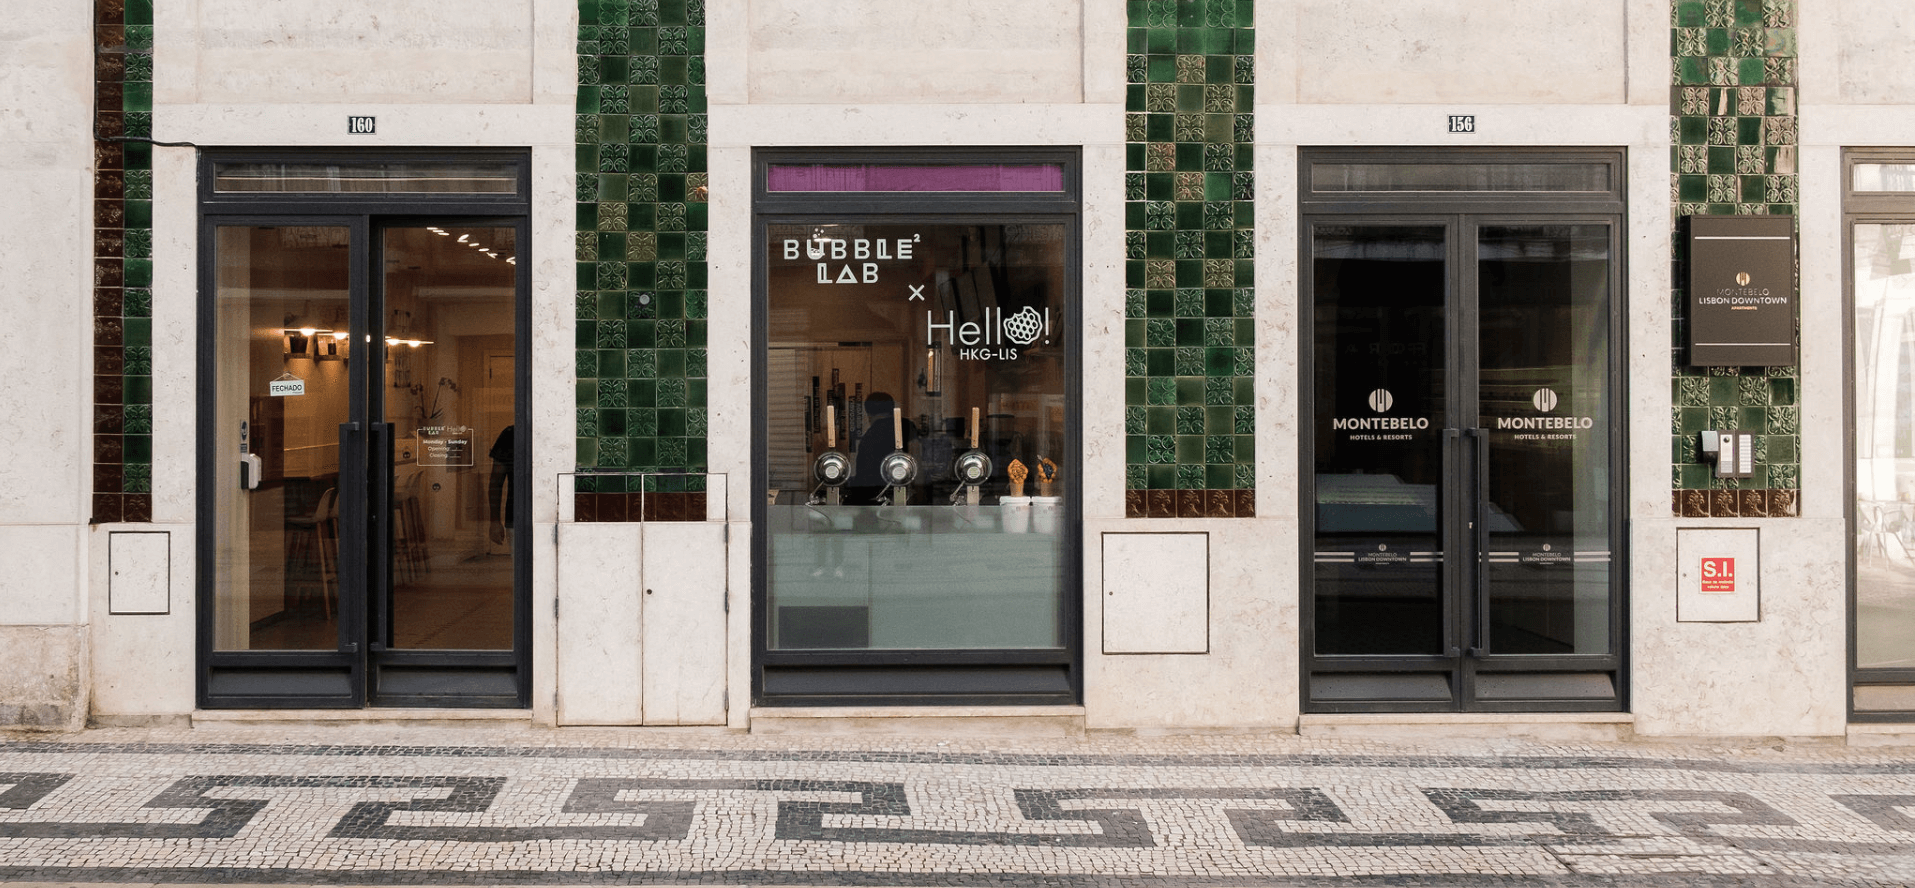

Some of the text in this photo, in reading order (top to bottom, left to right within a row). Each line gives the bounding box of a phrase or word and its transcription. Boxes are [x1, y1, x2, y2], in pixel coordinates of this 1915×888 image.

[351, 117, 373, 133] 160
[1451, 116, 1473, 132] 156
[817, 262, 879, 284] LAB
[1716, 288, 1770, 296] MONTEBELO
[960, 348, 1018, 360] HKG-LIS
[271, 384, 303, 392] FECHADO
[1333, 417, 1429, 430] MONTEBELO
[1497, 417, 1593, 429] MONTEBELO
[1703, 560, 1734, 577] S.I.
